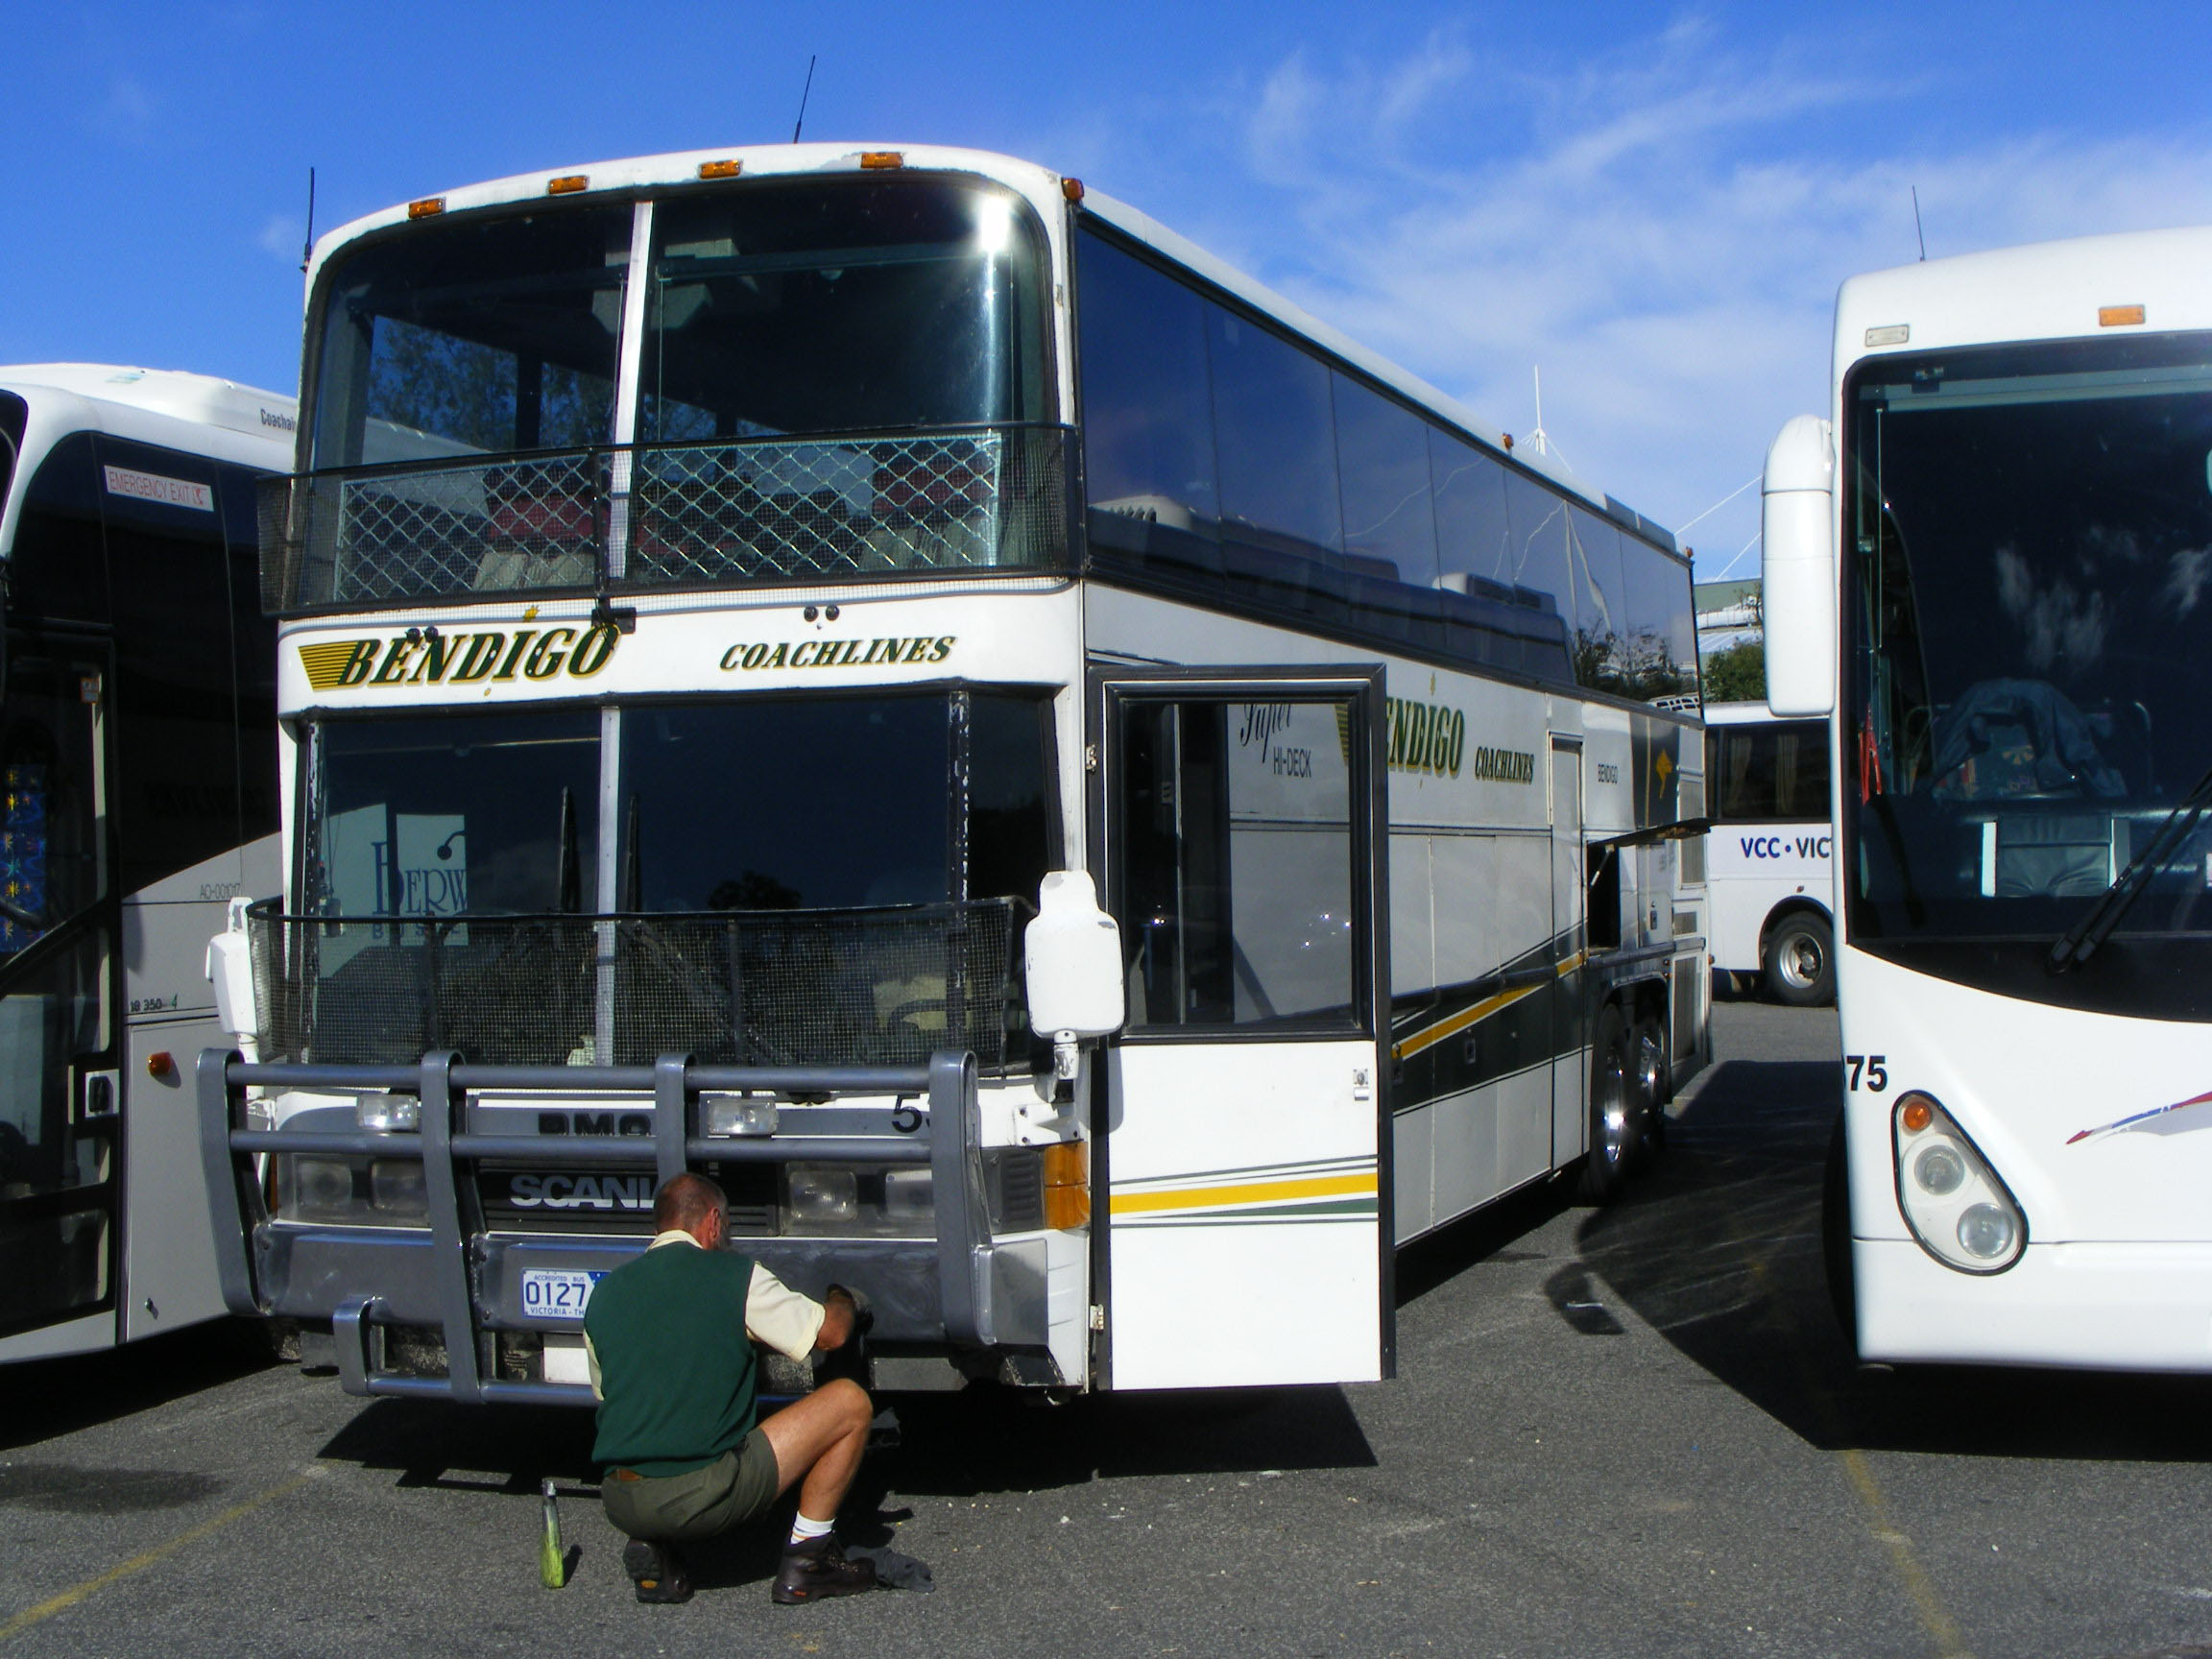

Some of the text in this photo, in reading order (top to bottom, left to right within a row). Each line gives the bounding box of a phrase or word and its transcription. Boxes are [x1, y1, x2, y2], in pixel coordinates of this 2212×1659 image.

[108, 469, 190, 503] EMERGENCY EXIT
[336, 624, 958, 688] BENDIGO COACHLINES
[1272, 746, 1312, 779] HI-DECK
[1475, 745, 1535, 785] COACHLINES
[1740, 836, 1781, 859] VCC
[1845, 1054, 1888, 1093] 75
[891, 1093, 929, 1134] 5
[510, 1173, 659, 1209] SCANI
[525, 1281, 587, 1307] 0127
[534, 1274, 567, 1283] ACCREDITED
[530, 1307, 566, 1315] VICTORIA
